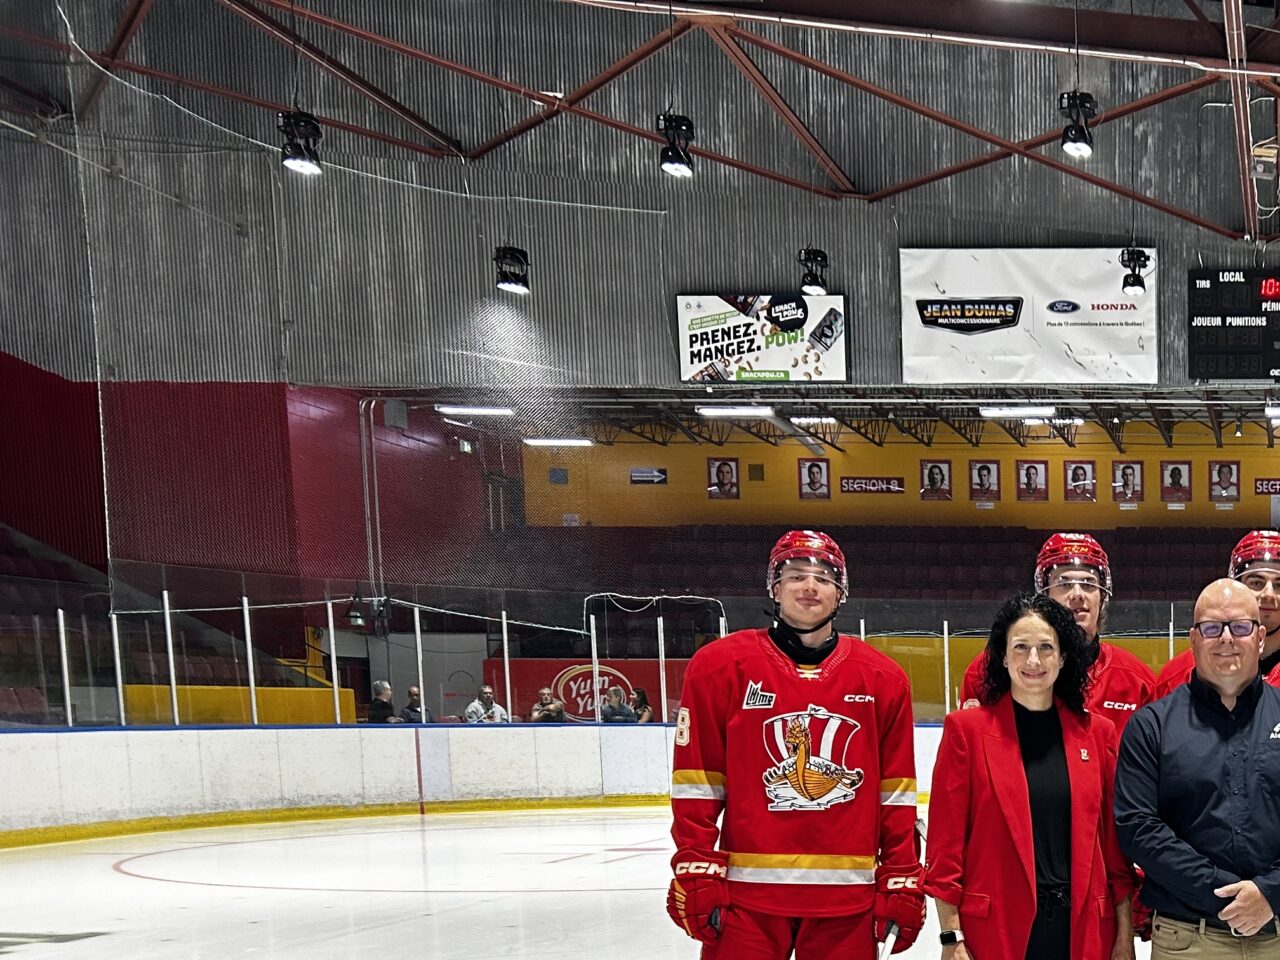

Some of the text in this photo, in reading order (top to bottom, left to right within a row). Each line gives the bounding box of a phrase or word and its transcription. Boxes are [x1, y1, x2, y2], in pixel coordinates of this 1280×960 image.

[1219, 272, 1245, 282] LOCAL
[1196, 280, 1211, 288] TIRS
[775, 302, 797, 313] SNACK
[923, 303, 1015, 317] JEAN DUMAS
[1053, 303, 1073, 312] Ford
[1091, 303, 1138, 311] HONDA
[783, 308, 798, 318] POW
[1192, 317, 1267, 327] JOUEUR PUNITIONS
[689, 323, 758, 349] PRENEZ.
[689, 328, 805, 365] MANGEZ. POW!
[841, 479, 887, 491] SECTION
[843, 694, 875, 703] CCM
[1103, 700, 1137, 711] CCM
[675, 861, 728, 878] CCM
[886, 877, 918, 890] CC
